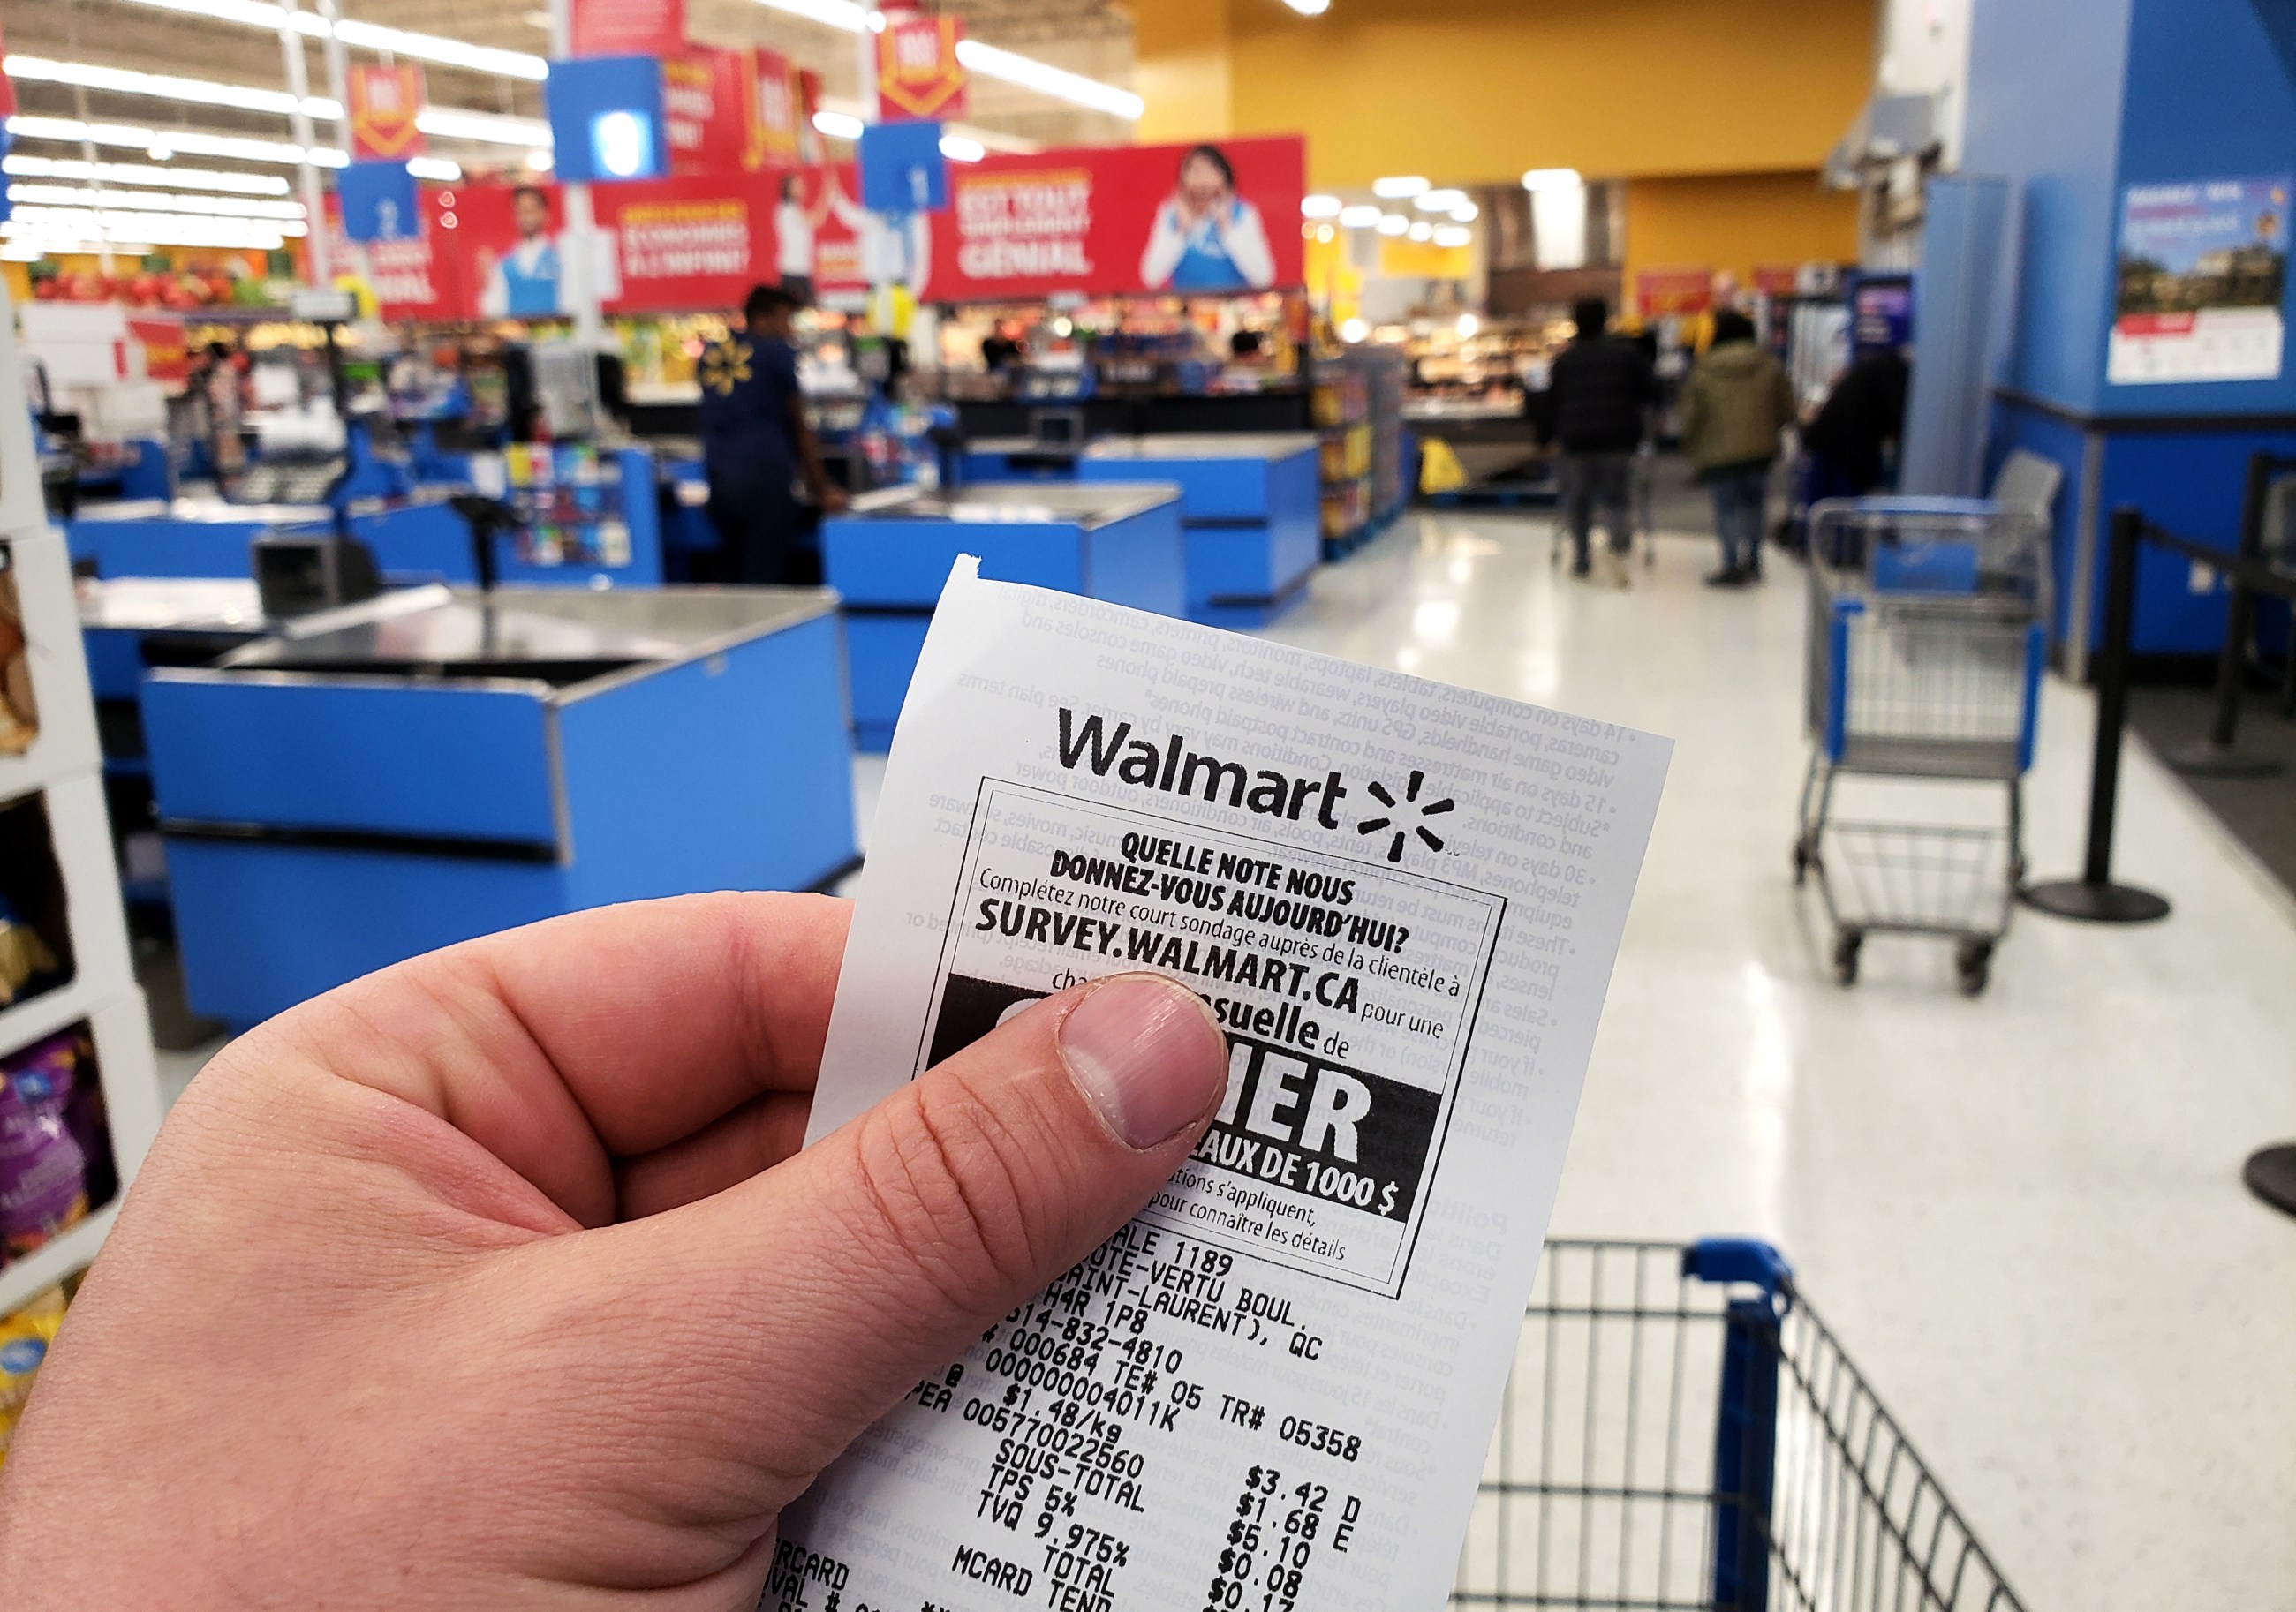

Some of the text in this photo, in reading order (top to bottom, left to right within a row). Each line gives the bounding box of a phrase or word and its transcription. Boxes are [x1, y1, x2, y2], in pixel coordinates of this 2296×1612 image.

[1058, 706, 1347, 830] Walmart
[1049, 848, 1409, 954] DONNEZ-VOUS AUJOURD'HUI?
[1120, 832, 1356, 906] QUELLE NOTE NOUS
[974, 897, 1358, 1013] SURVEY.WALMART.CA
[1360, 1002, 1405, 1026] pour
[1408, 1016, 1443, 1039] une
[979, 867, 1460, 997] Complétez notre court sondage auprès de la clientèle à
[1197, 993, 1349, 1059] suelle de
[1148, 1190, 1190, 1213] pour
[1189, 1202, 1263, 1236] connaître
[1265, 1220, 1288, 1244] les
[1291, 1231, 1345, 1260] détails
[1216, 1180, 1315, 1226] s'appliquent,
[1260, 1147, 1301, 1185] DE
[1302, 1162, 1375, 1206] 1000
[1377, 1180, 1399, 1221] $
[1086, 1242, 1305, 1330] OTE-VERTU BOUL.
[1175, 1240, 1230, 1275] 1189
[1042, 1286, 1148, 1335] H4R 1P8
[1072, 1265, 1323, 1360] AINT-LAURENT), QC
[986, 1349, 1179, 1431] 000000004011K
[1008, 1329, 1100, 1373] 000684
[1114, 1360, 1158, 1395] TE#
[1167, 1379, 1204, 1410] 05
[1220, 1393, 1265, 1431] TR#
[1279, 1415, 1361, 1462] 05358
[962, 1397, 1144, 1479] 005770022560
[1231, 1491, 1323, 1540] $1.68
[1332, 1522, 1354, 1553] E
[1001, 1382, 1122, 1444] $1.48/kg
[1240, 1465, 1328, 1512] $3.42
[1341, 1495, 1361, 1524] D
[977, 1488, 1023, 1531] TVQ
[1033, 1507, 1129, 1568] 9.975%
[987, 1462, 1305, 1599] TPS 5% $0.08
[994, 1437, 1144, 1513] SOUS-TOTAL
[1221, 1519, 1314, 1570] $5.10
[951, 1544, 1114, 1612] MCARD TEND
[1042, 1544, 1114, 1598] TOTAL
